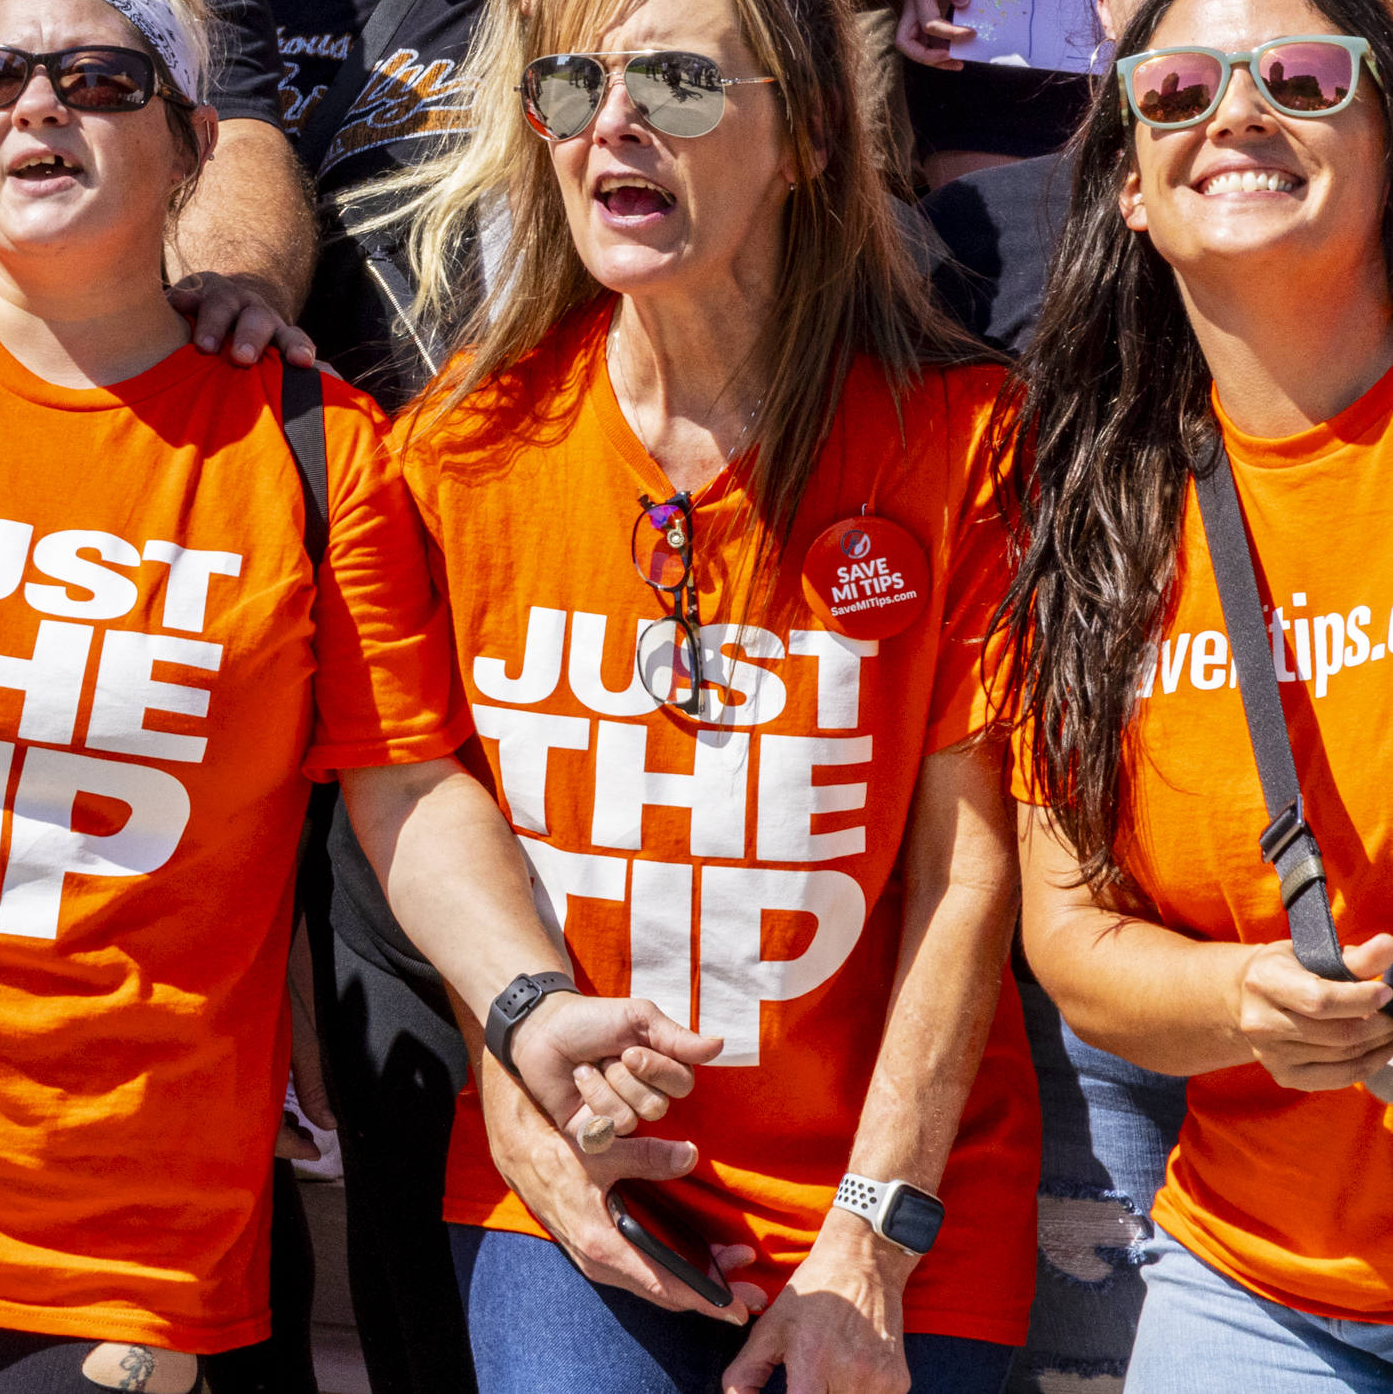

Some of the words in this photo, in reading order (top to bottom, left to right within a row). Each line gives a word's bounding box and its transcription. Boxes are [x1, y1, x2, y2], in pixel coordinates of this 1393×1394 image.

[830, 590, 917, 617] SaveMITips.com
[831, 583, 859, 603] MI
[859, 572, 905, 597] TIPS
[837, 557, 890, 584] SAVE
[472, 605, 879, 730] JUST
[471, 703, 873, 863] THE
[517, 834, 866, 1067] TIP
